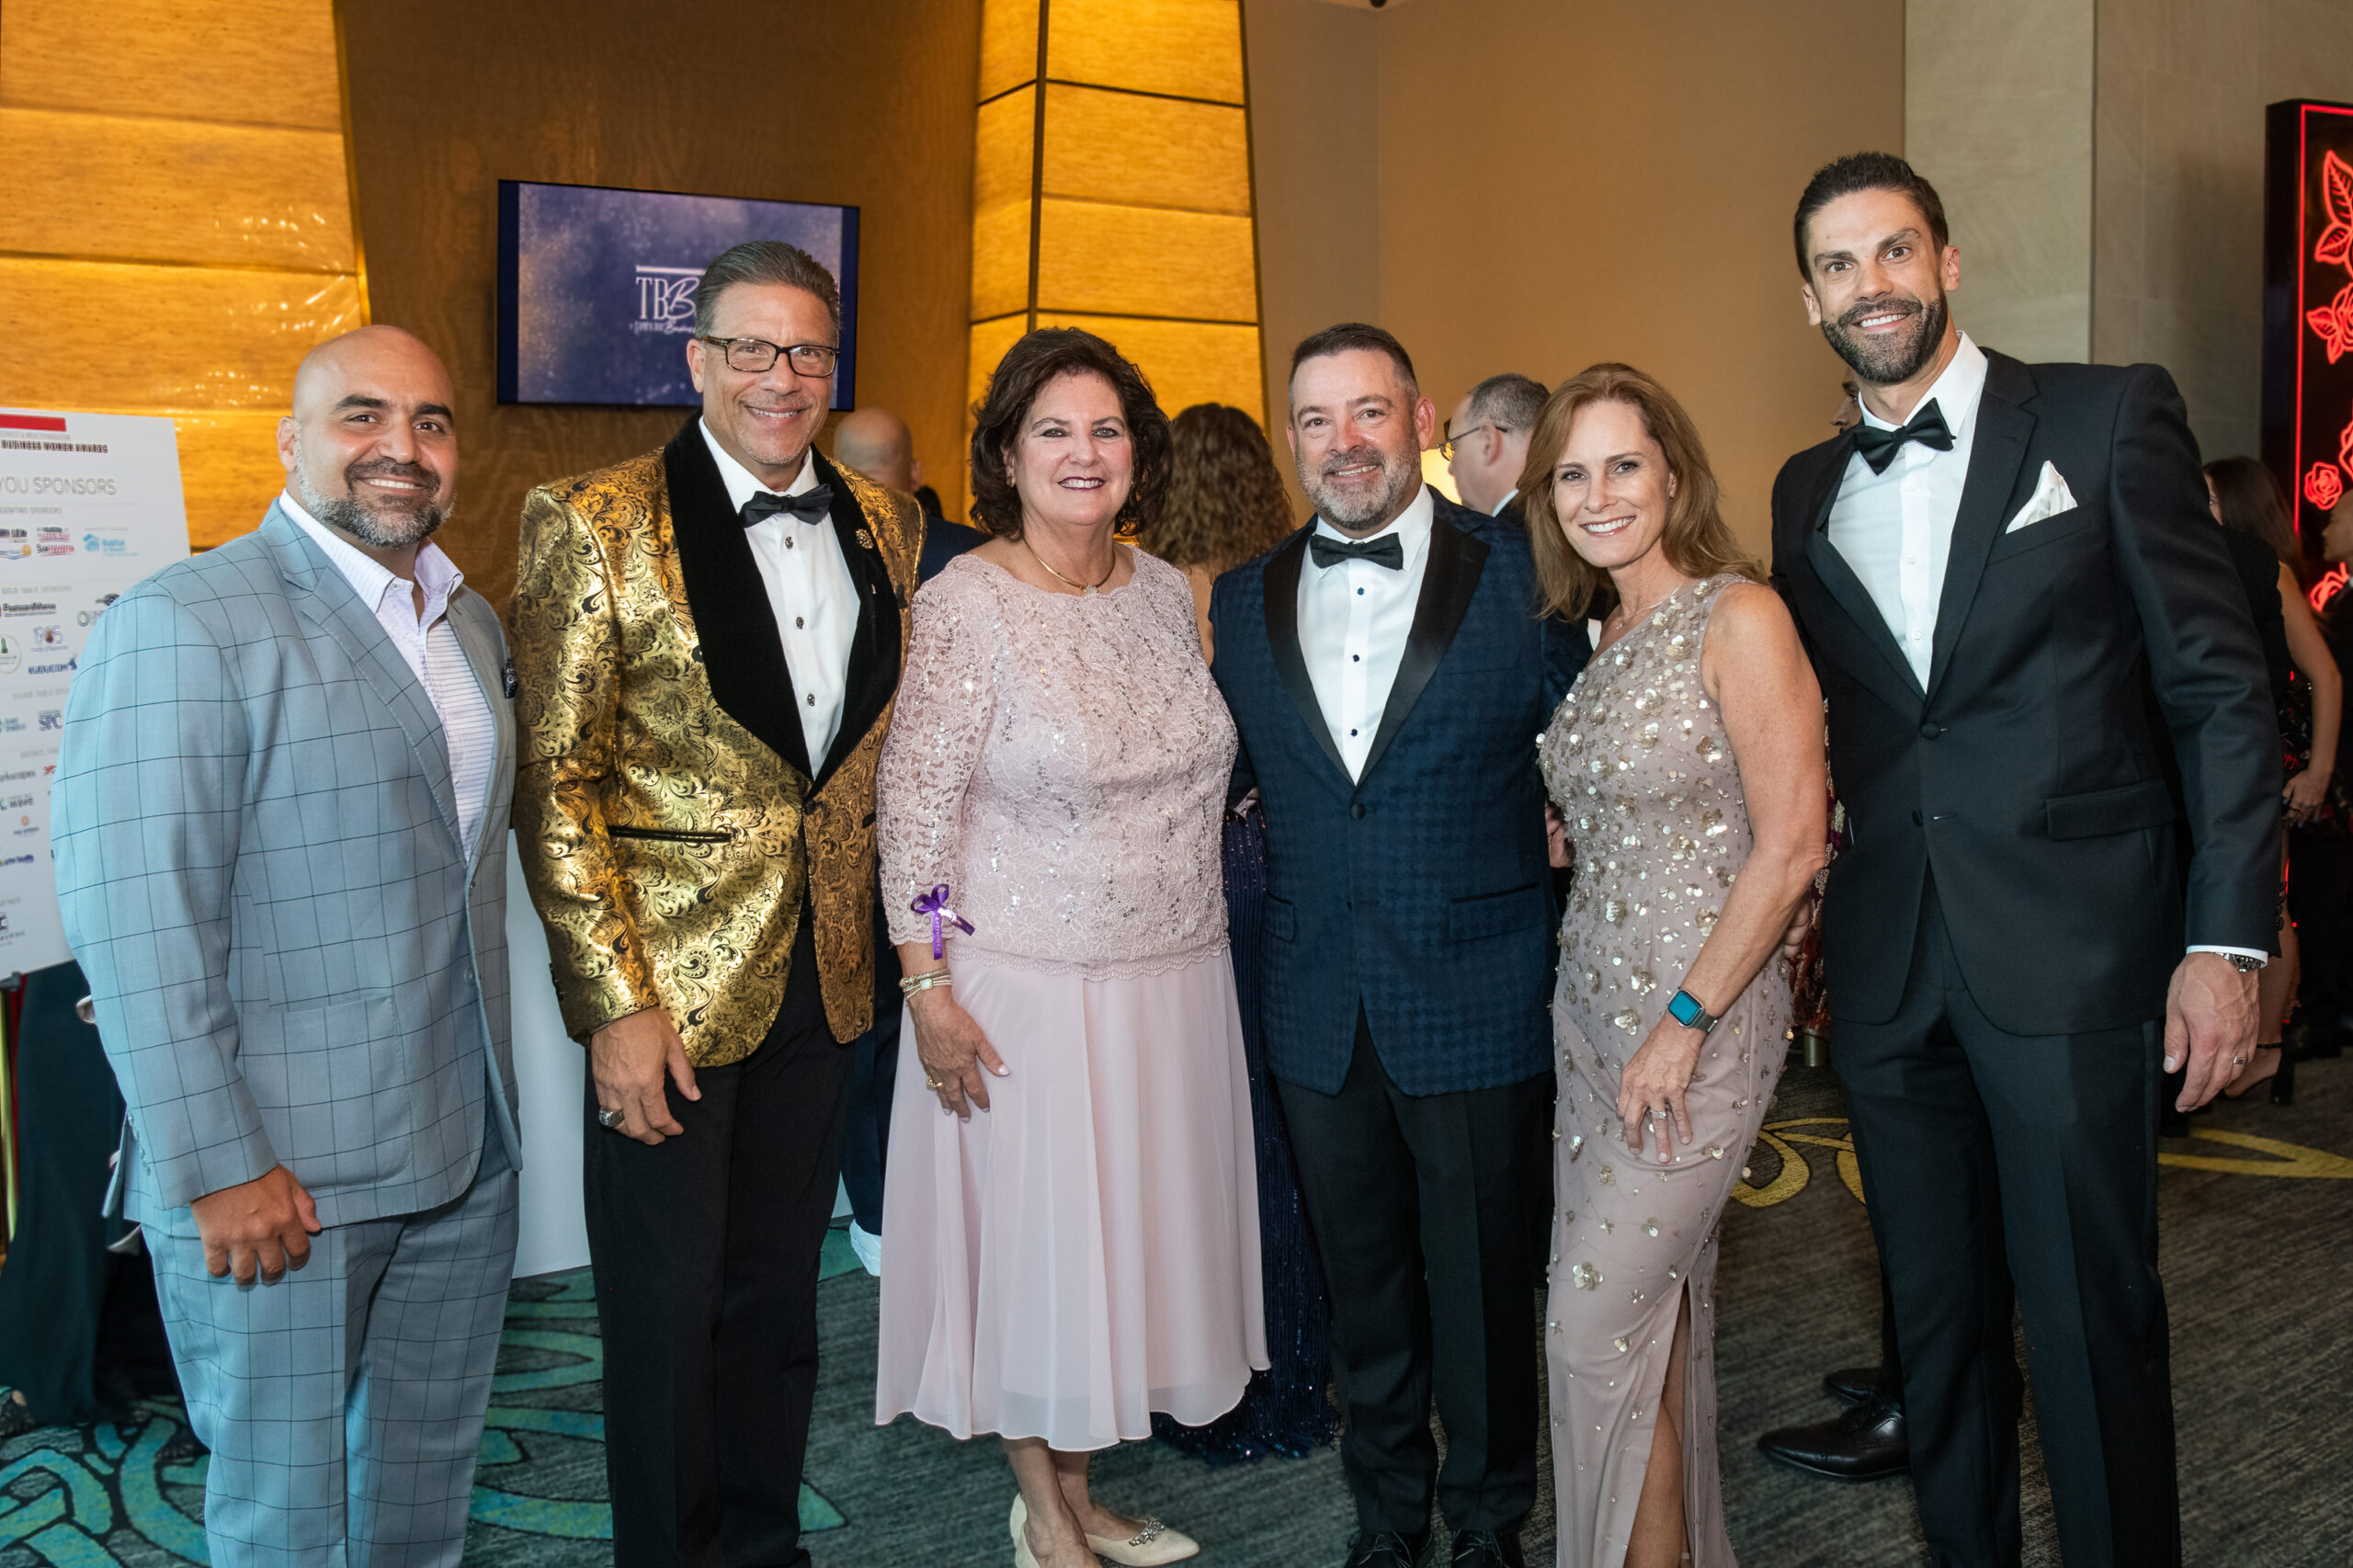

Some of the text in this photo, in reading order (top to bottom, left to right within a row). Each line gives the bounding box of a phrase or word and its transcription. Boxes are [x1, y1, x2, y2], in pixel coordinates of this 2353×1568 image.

[1, 439, 42, 450] BUSINESS
[74, 443, 108, 454] AWARDS
[33, 476, 117, 495] SPONSORS
